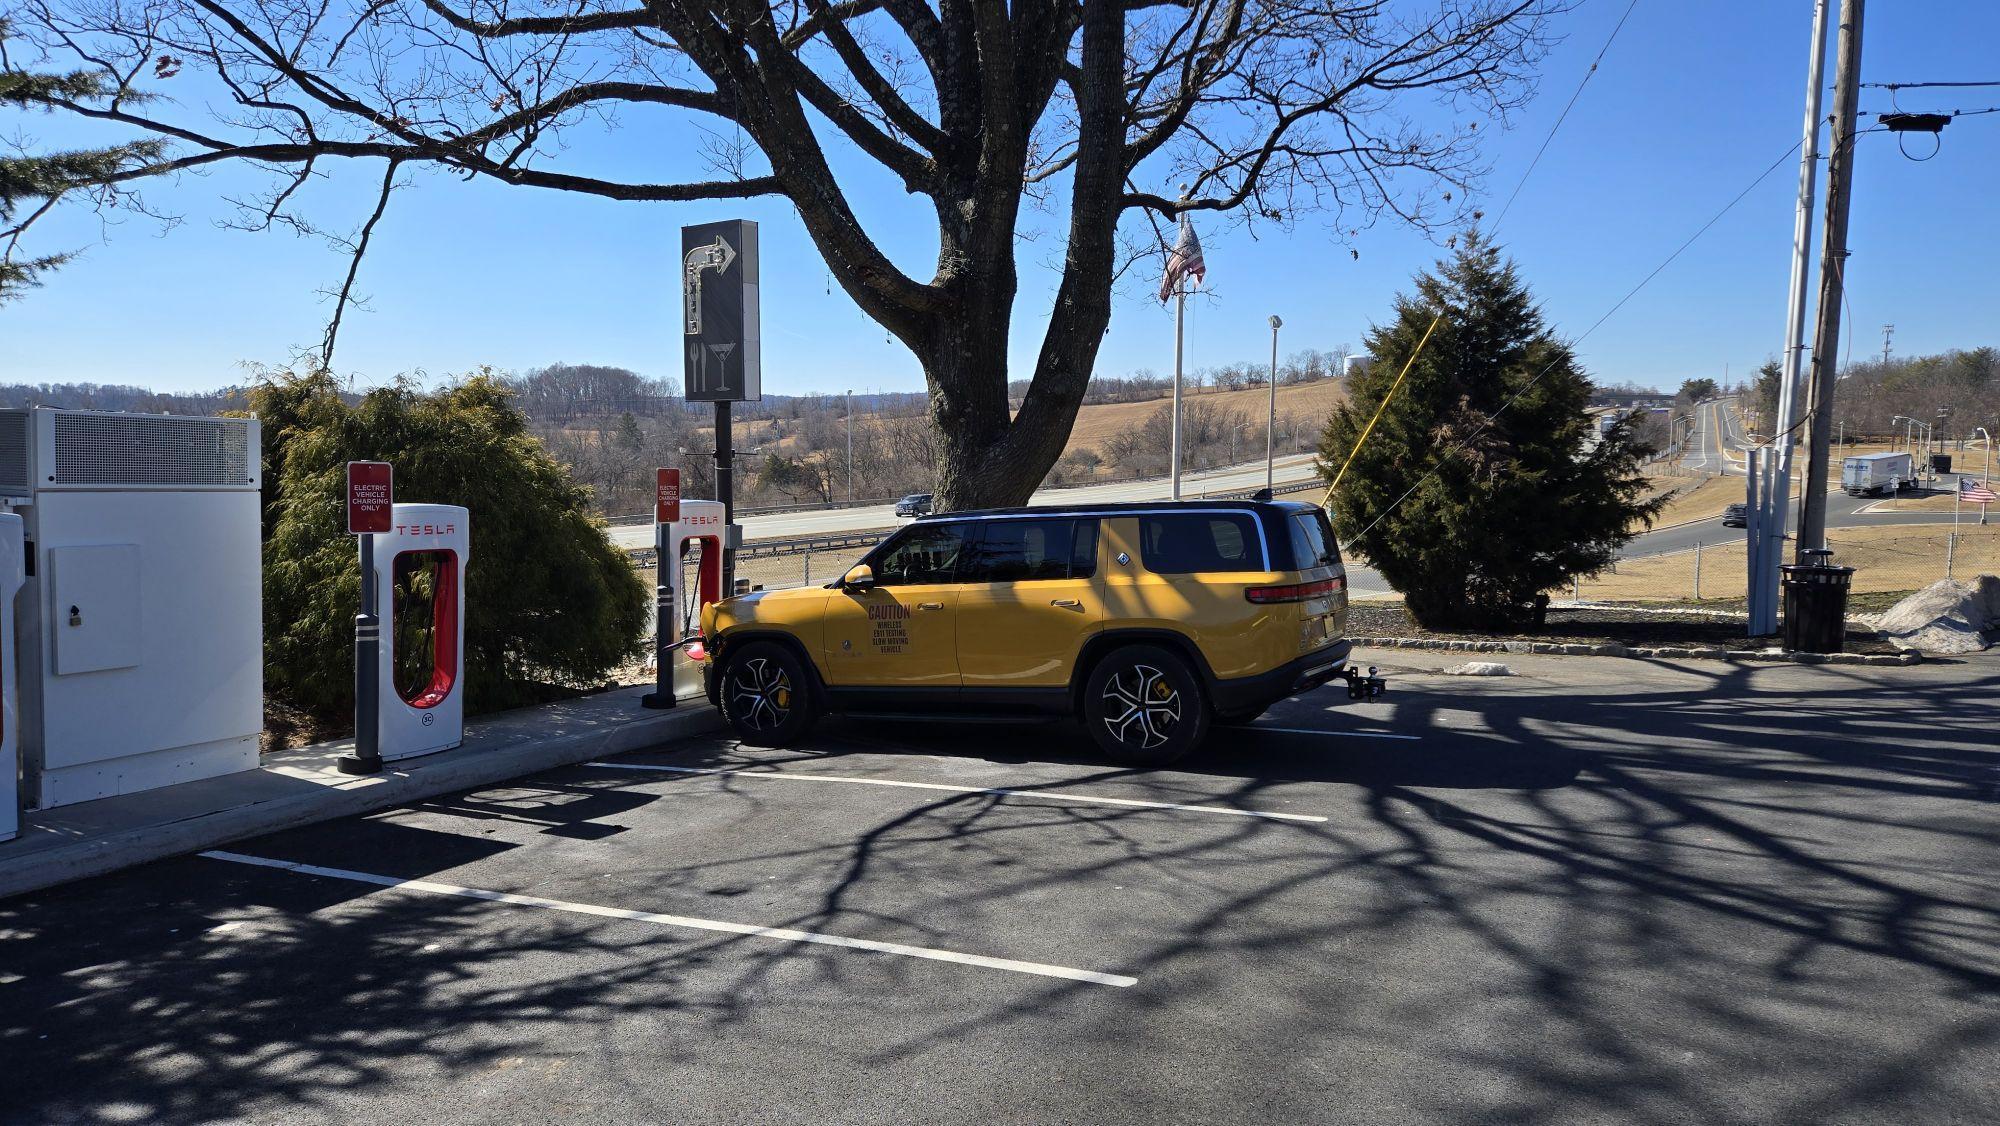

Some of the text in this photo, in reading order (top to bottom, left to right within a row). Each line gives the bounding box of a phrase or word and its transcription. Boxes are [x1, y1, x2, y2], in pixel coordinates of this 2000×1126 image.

[682, 516, 718, 525] TESLA
[396, 524, 455, 536] TESLA
[868, 604, 911, 620] CAUTION
[877, 620, 902, 629] WIRELESS
[872, 637, 909, 646] SLOW MOVING
[880, 645, 902, 654] VEHICLE
